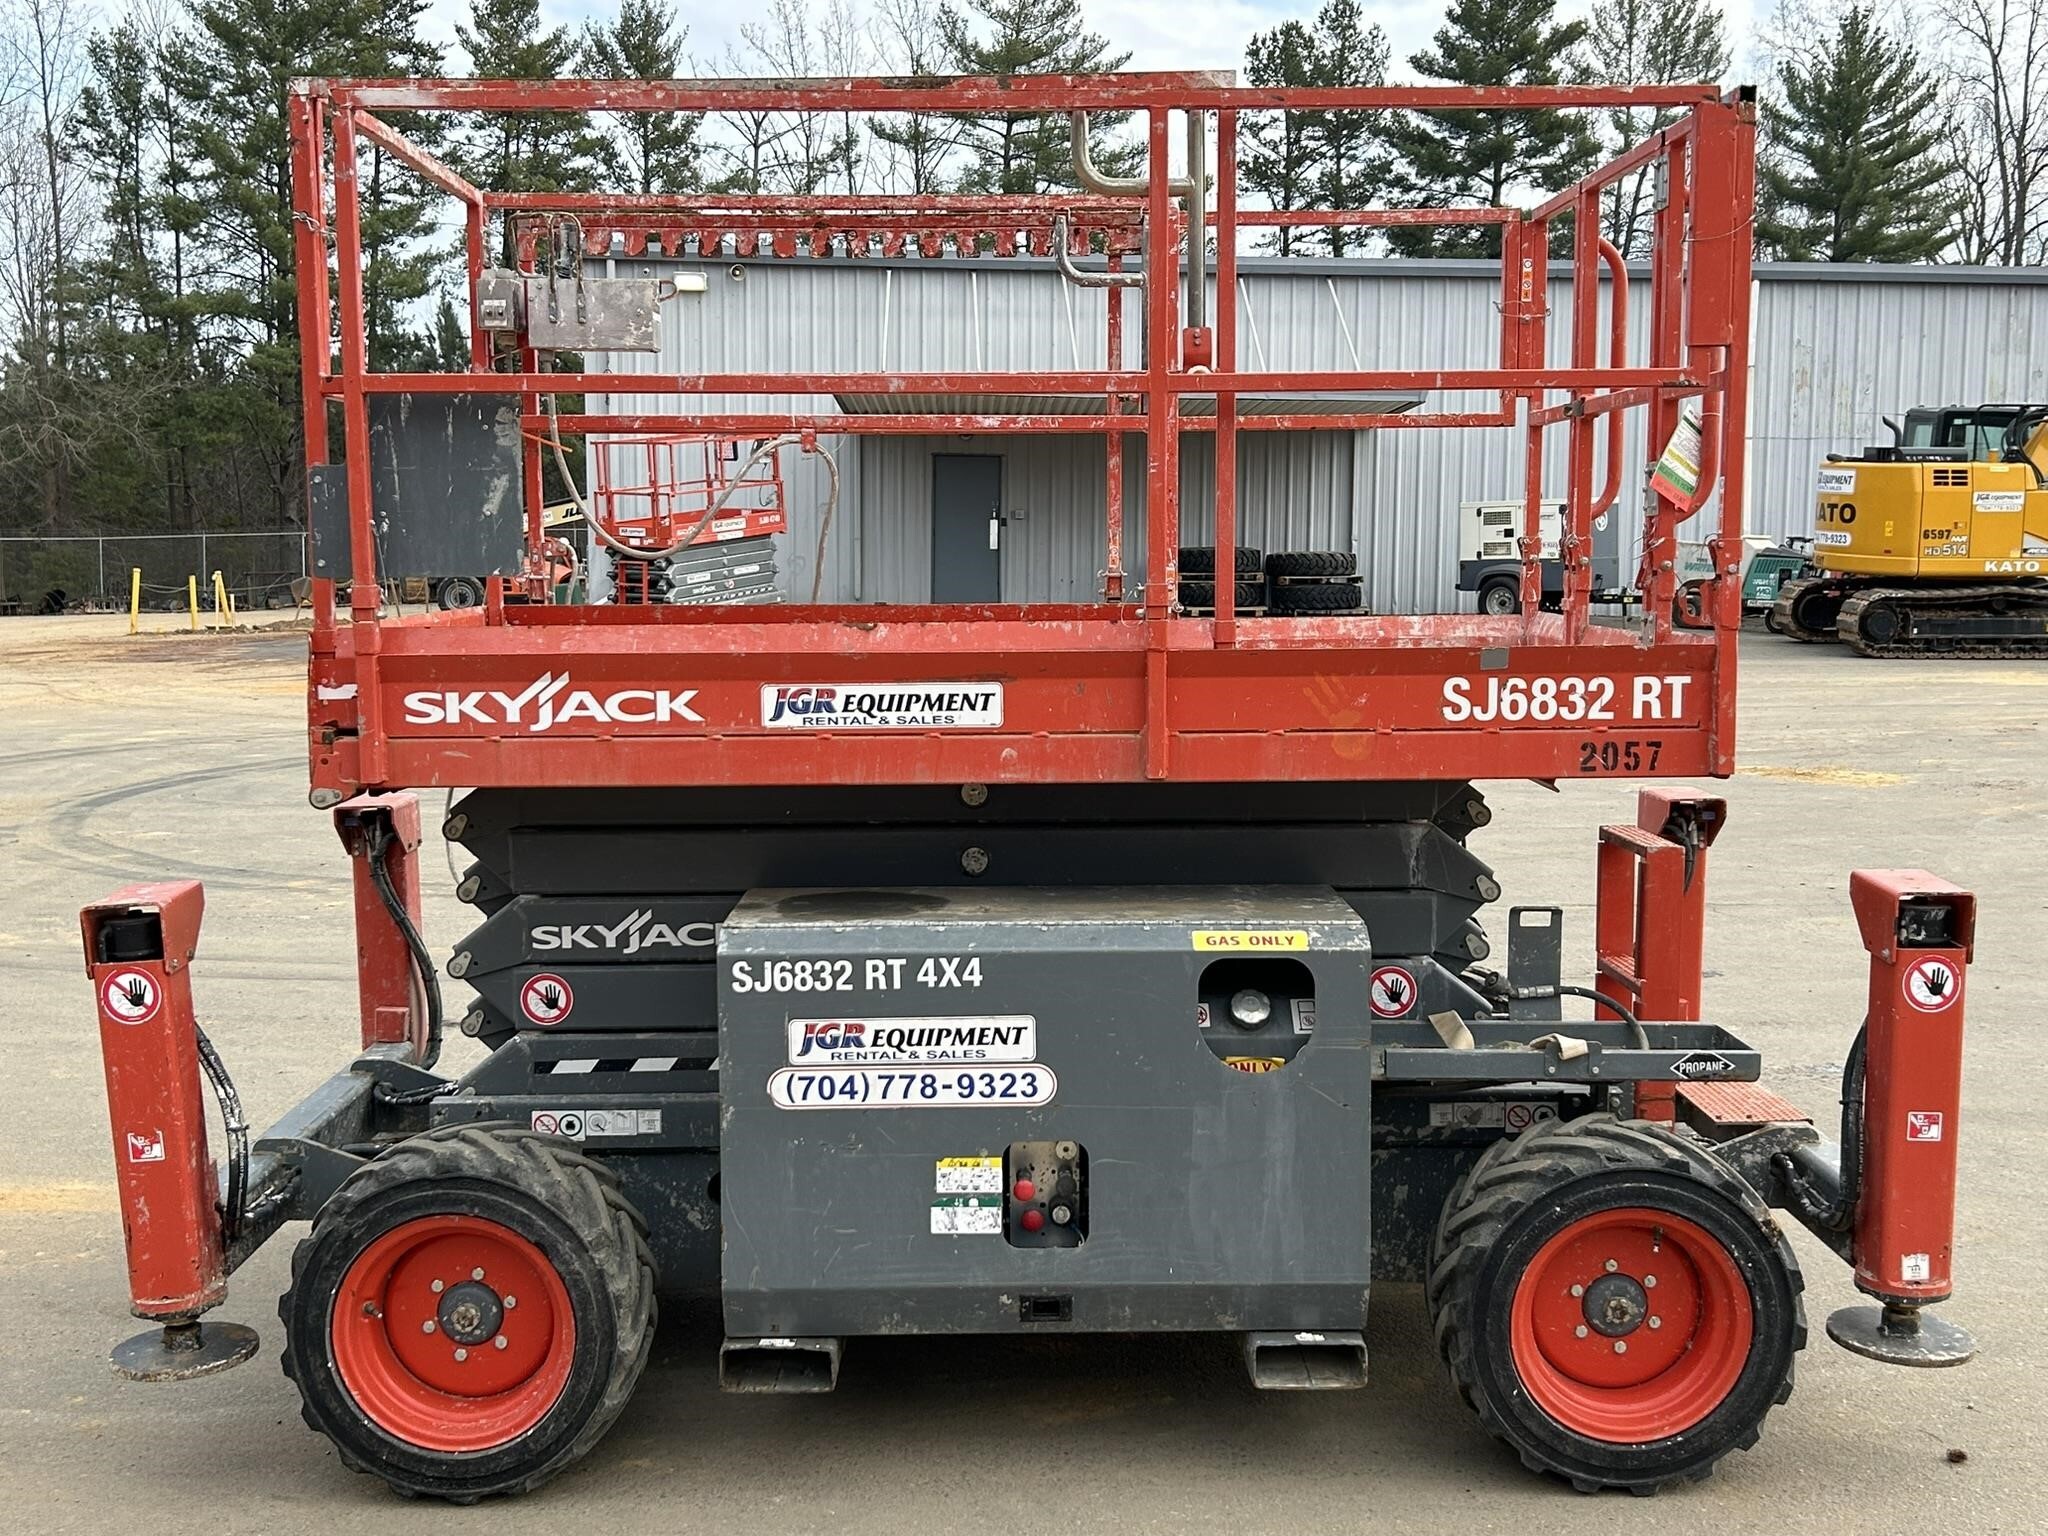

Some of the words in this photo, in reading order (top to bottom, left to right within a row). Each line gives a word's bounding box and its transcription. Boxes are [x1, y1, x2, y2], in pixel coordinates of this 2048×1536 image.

[1923, 529, 1952, 540] 6597
[1984, 560, 2040, 573] KATO
[404, 671, 705, 732] SKYJACK
[769, 687, 837, 723] JGR
[840, 691, 996, 718] EQUIPMENT
[1442, 676, 1615, 721] SJ6832
[1632, 675, 1692, 719] RT
[803, 715, 874, 727] RENTAL
[877, 715, 892, 726] &
[897, 714, 956, 726] SALES
[1579, 741, 1662, 773] 2057
[531, 908, 718, 955] SKYJAC
[1206, 936, 1240, 946] GAS
[1249, 936, 1294, 946] ONLY
[732, 959, 854, 993] SJ6832
[865, 958, 907, 990] RT
[916, 956, 984, 988] 4X4
[796, 1021, 866, 1057] JGR
[870, 1025, 1028, 1053] EQUIPMENT
[831, 1051, 906, 1061] RENTAL
[909, 1050, 919, 1060] &
[926, 1049, 987, 1060] SALES
[1679, 1060, 1725, 1074] PROPANE
